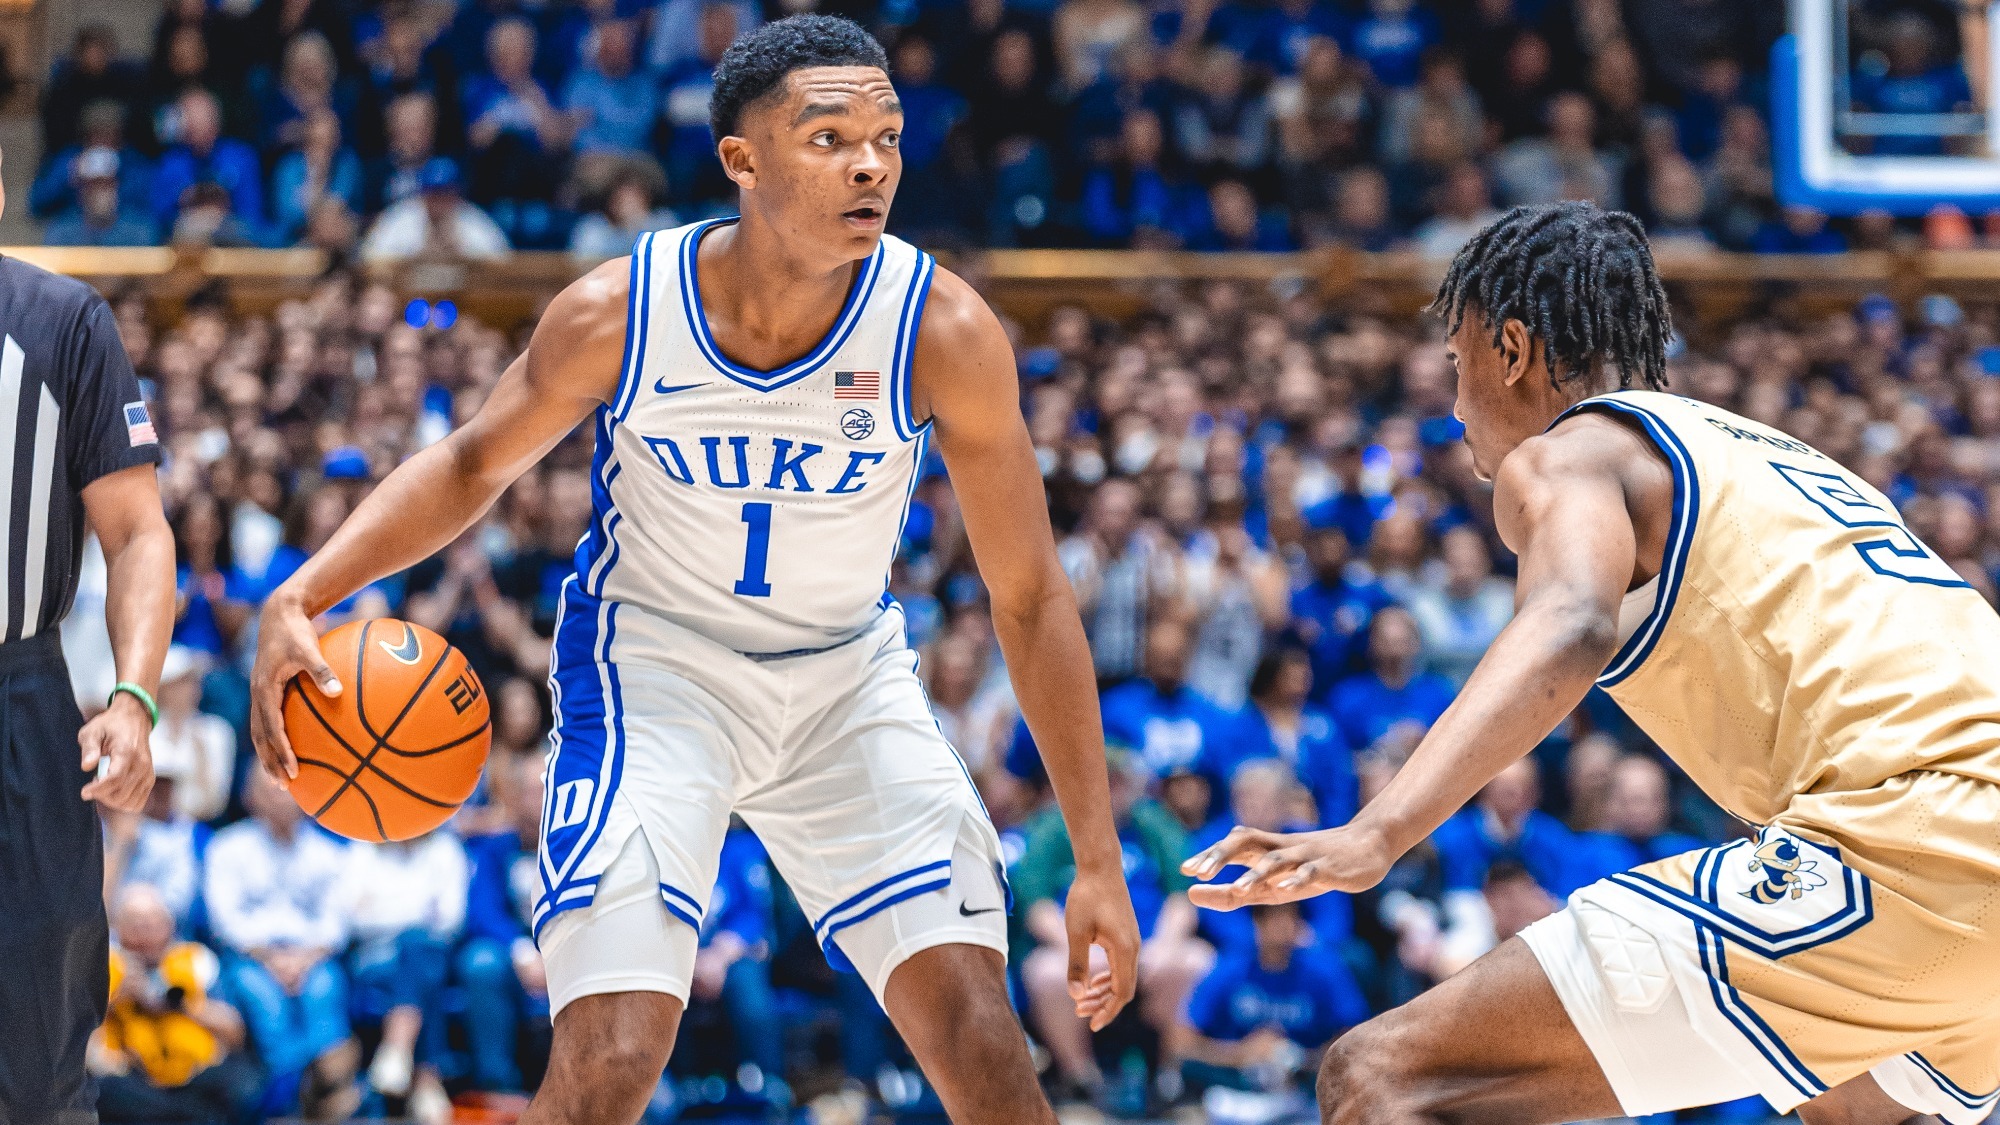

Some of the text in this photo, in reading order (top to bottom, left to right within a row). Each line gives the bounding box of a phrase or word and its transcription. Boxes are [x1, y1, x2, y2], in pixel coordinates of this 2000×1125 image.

[842, 418, 873, 429] ACC
[641, 435, 886, 494] DUKE
[734, 502, 772, 598] 1
